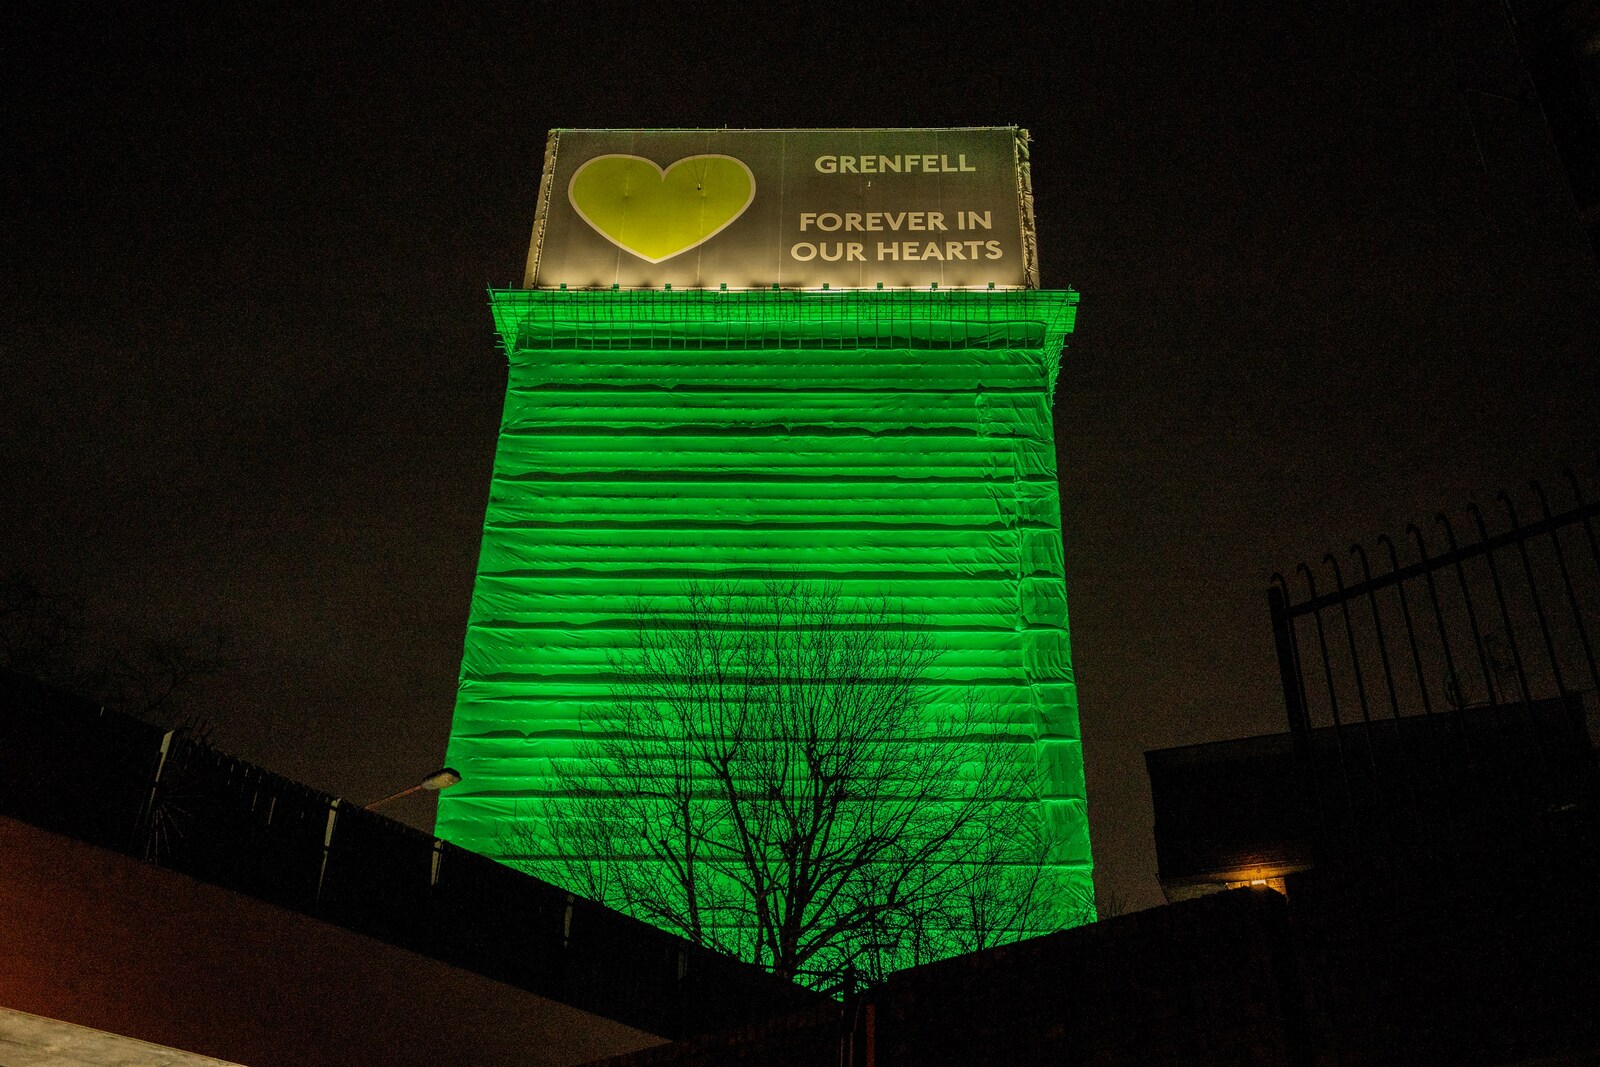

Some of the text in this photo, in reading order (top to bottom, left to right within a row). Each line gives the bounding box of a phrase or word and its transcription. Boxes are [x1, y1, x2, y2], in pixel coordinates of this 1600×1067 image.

[814, 154, 976, 174] GRENFELL
[800, 210, 992, 232] FOREVER IN
[790, 240, 1003, 262] OUR HEARTS
